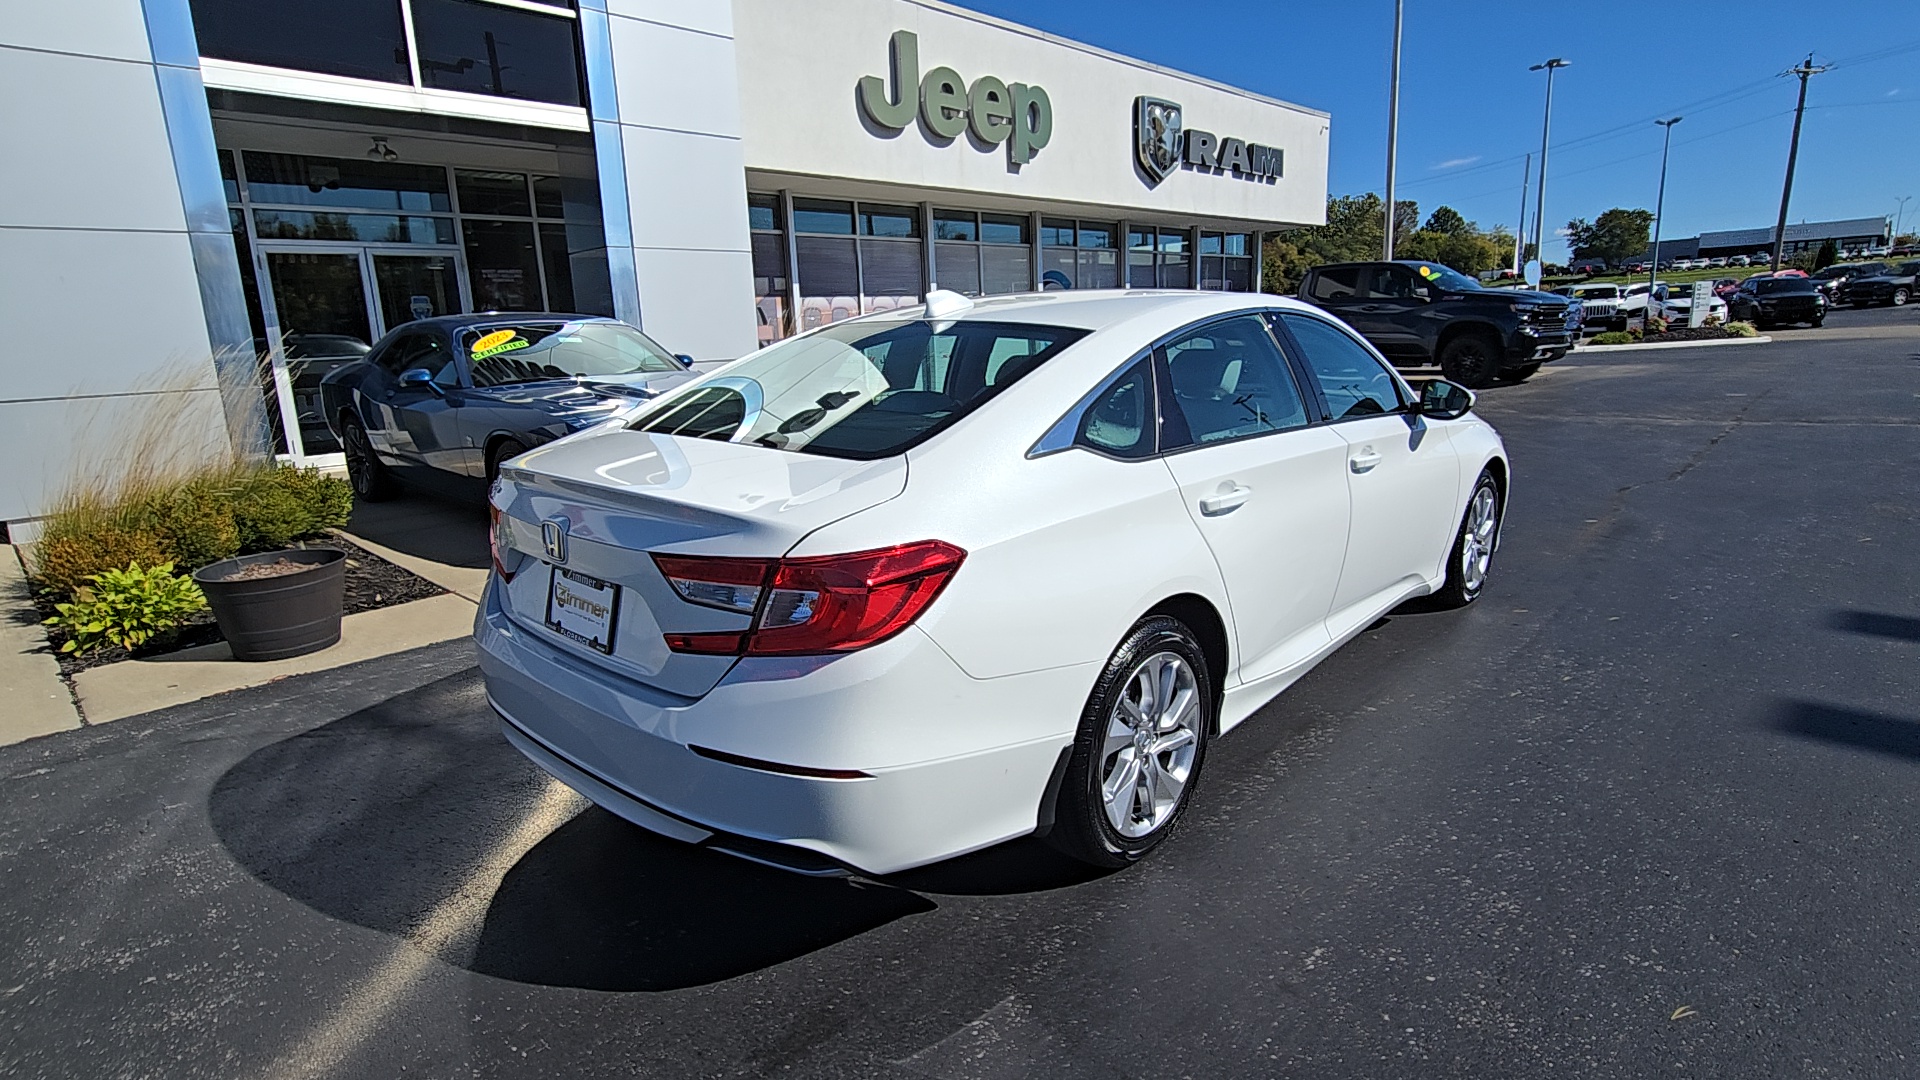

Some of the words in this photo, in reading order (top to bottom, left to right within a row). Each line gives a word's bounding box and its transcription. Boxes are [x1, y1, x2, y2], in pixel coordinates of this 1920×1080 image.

[859, 30, 1053, 164] Jeep
[1185, 129, 1285, 179] RAM
[474, 341, 526, 358] CERTIFIED
[480, 332, 509, 349] 2023
[566, 570, 597, 588] Zimmer
[555, 582, 609, 619] Zimmer
[560, 628, 590, 646] FLORENCE
